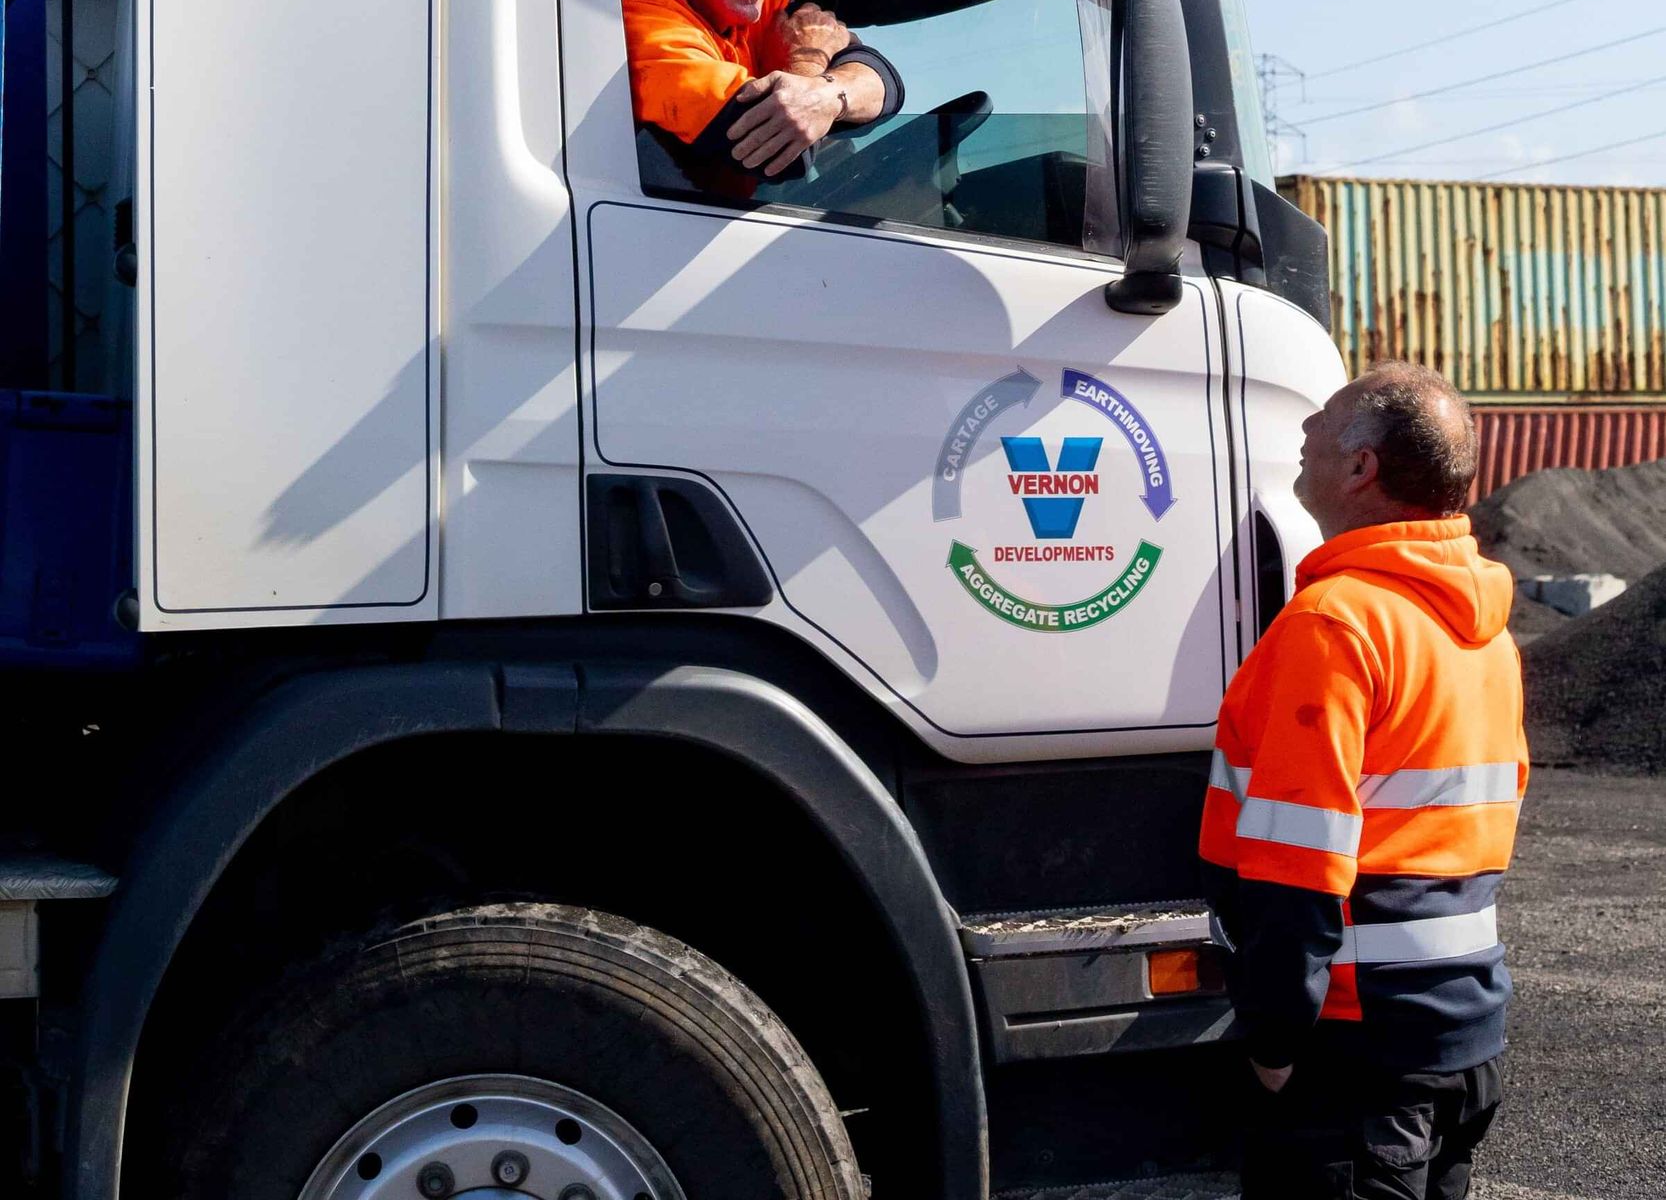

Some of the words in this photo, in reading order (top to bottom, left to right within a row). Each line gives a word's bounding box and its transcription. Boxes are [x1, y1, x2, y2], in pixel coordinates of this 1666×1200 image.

[943, 395, 999, 481] CARTAGE
[1074, 380, 1163, 487] EARTHMOVING
[1007, 474, 1099, 495] VERNON
[994, 545, 1115, 562] DEVELOPMENTS
[959, 564, 1060, 626] AGGREGATE
[1064, 557, 1150, 625] RECYCLING
